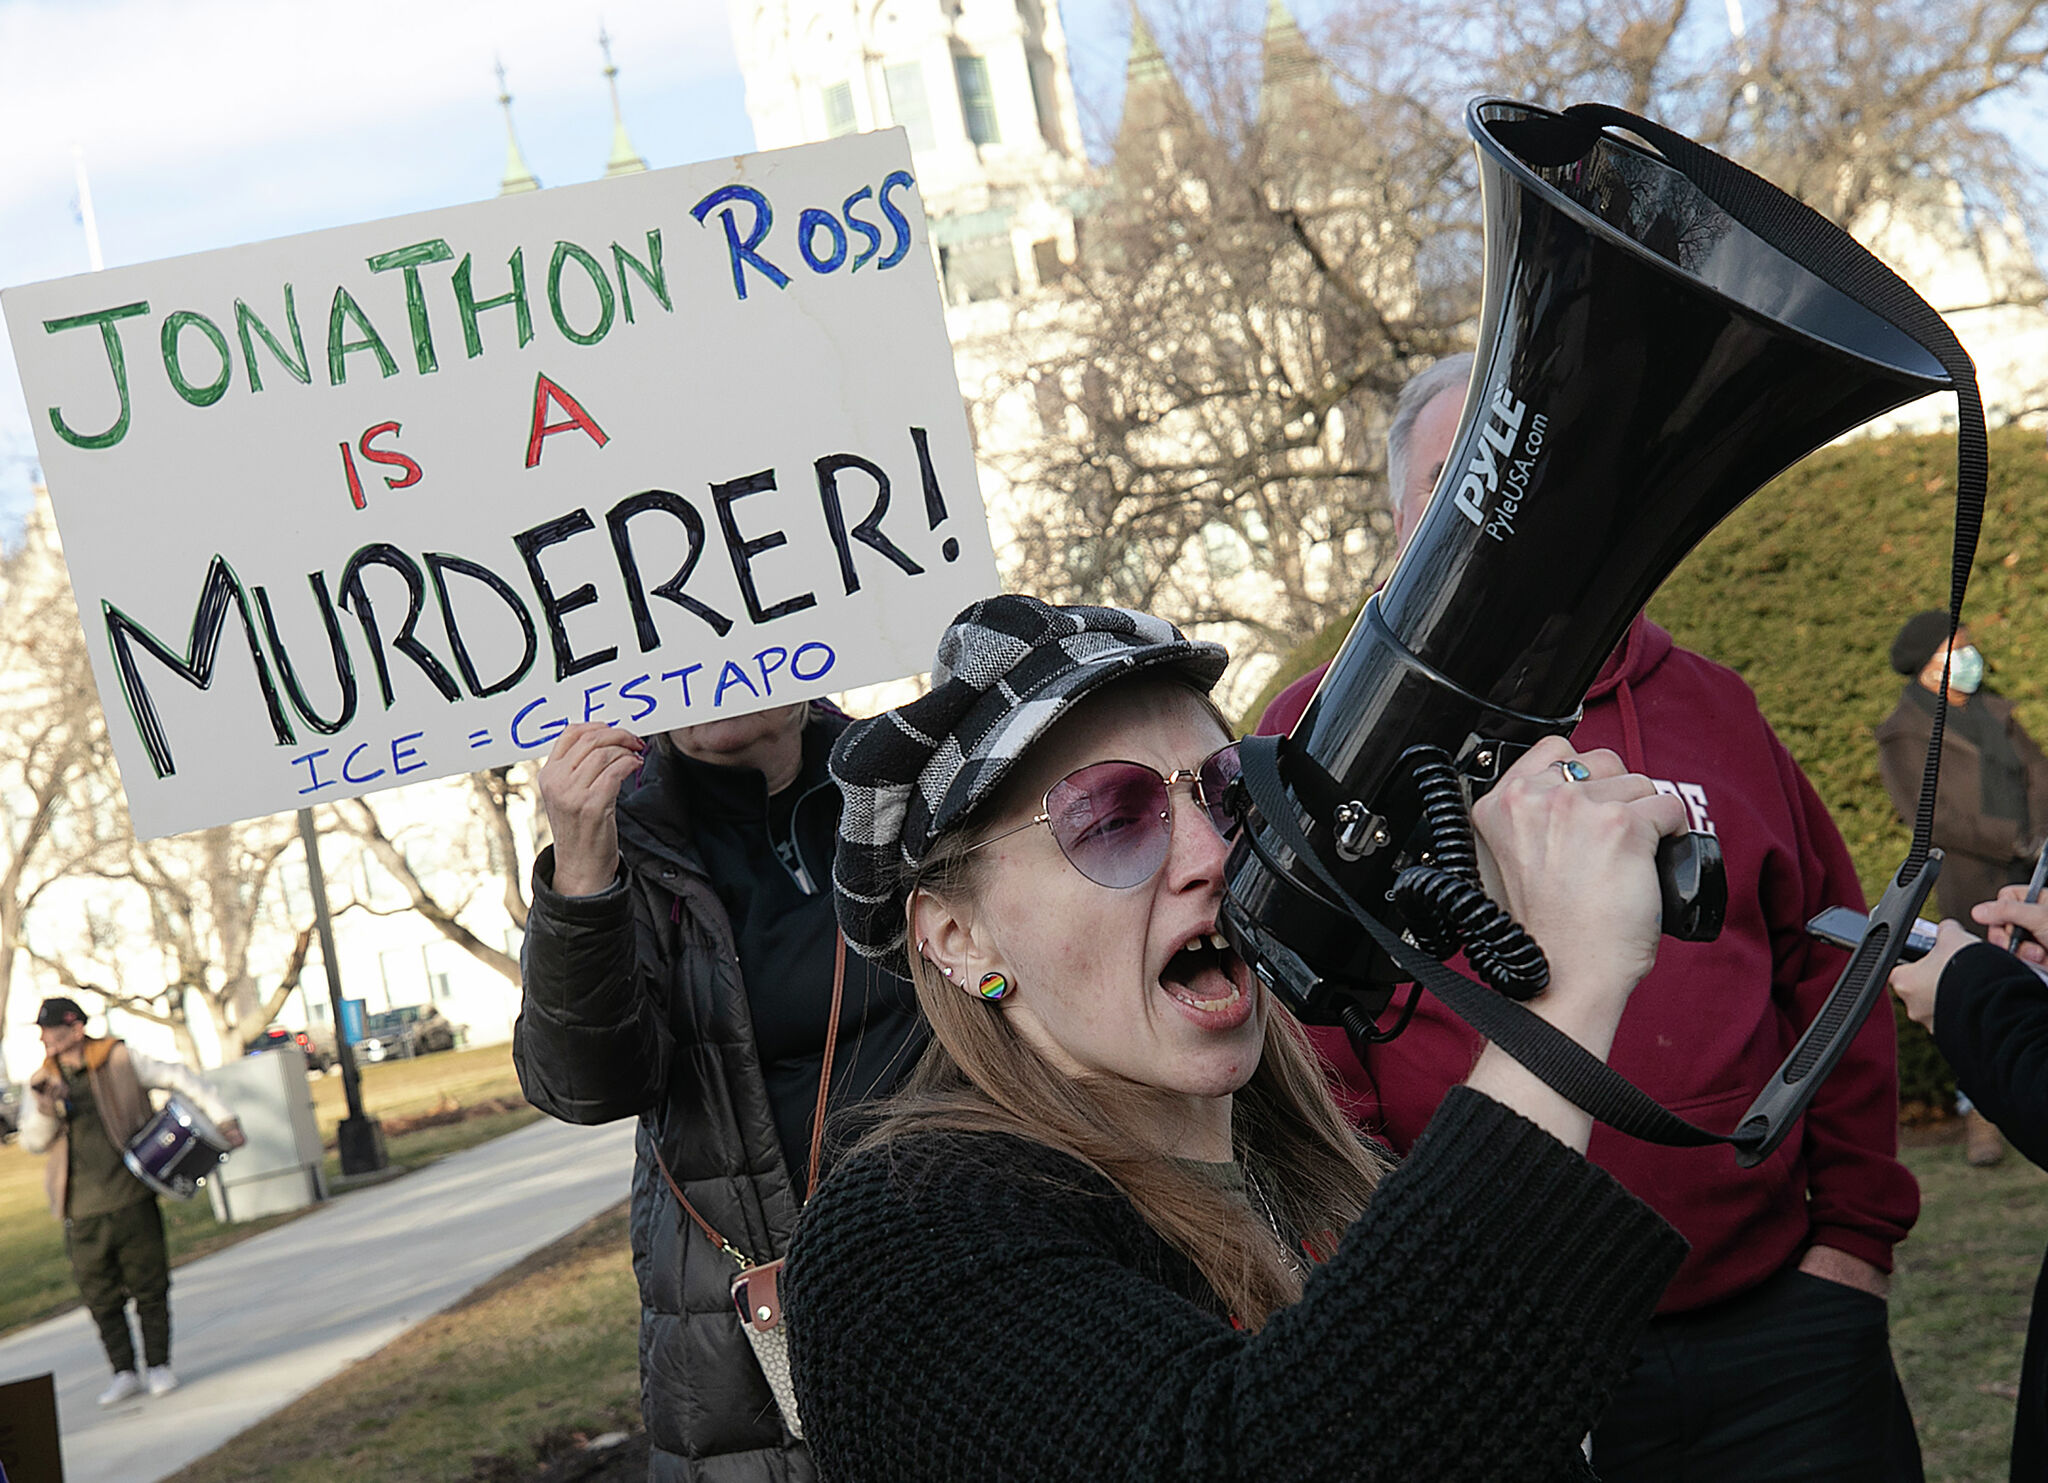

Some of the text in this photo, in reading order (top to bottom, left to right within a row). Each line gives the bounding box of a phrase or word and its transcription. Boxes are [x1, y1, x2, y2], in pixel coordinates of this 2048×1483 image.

[43, 170, 915, 449] JONATHON ROSS
[338, 371, 611, 510] IS A
[1453, 387, 1527, 527] PYLE
[1485, 413, 1549, 541] PyleUSA.com
[102, 426, 960, 780] MURDERER!
[291, 731, 427, 794] ICE
[510, 641, 837, 749] GESTAPO
